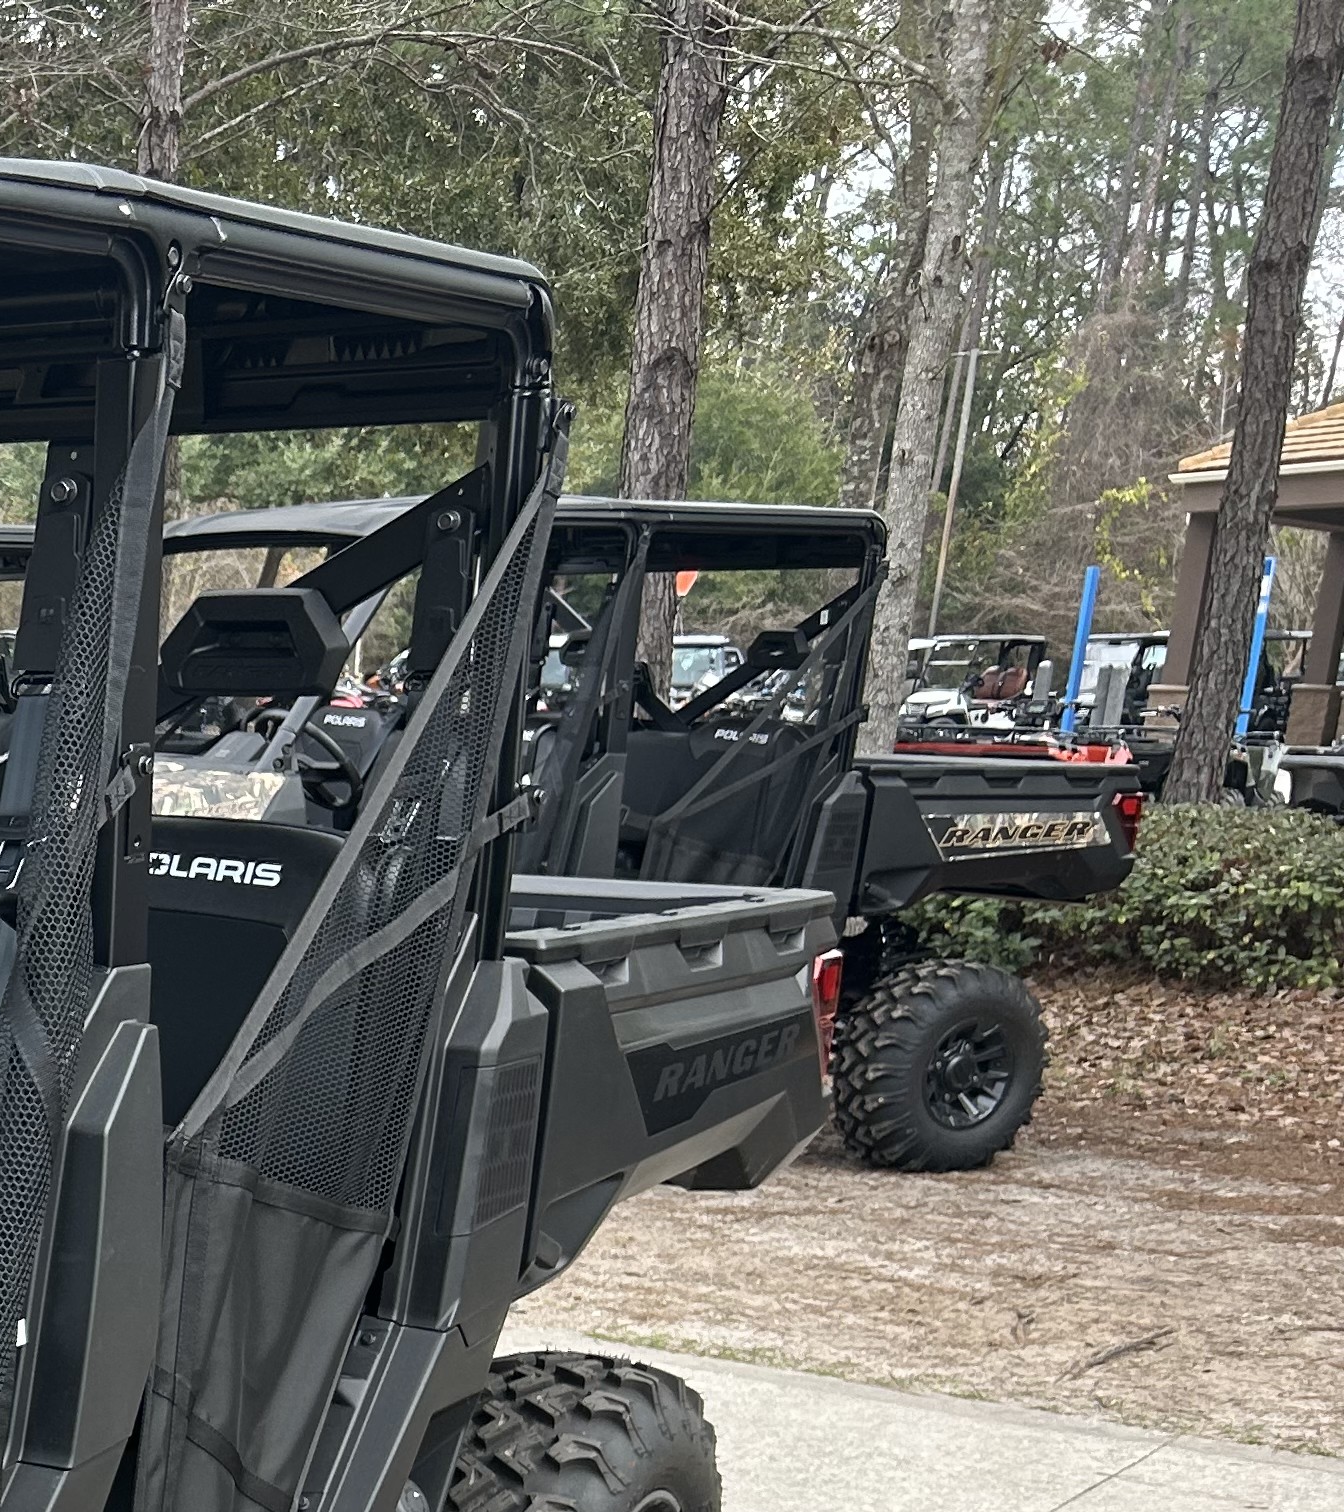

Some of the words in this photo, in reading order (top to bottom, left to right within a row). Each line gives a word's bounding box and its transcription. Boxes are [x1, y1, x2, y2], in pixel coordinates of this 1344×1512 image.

[939, 820, 1093, 848] RANGER
[148, 852, 283, 887] OLARIS
[653, 1023, 801, 1102] RANGER
